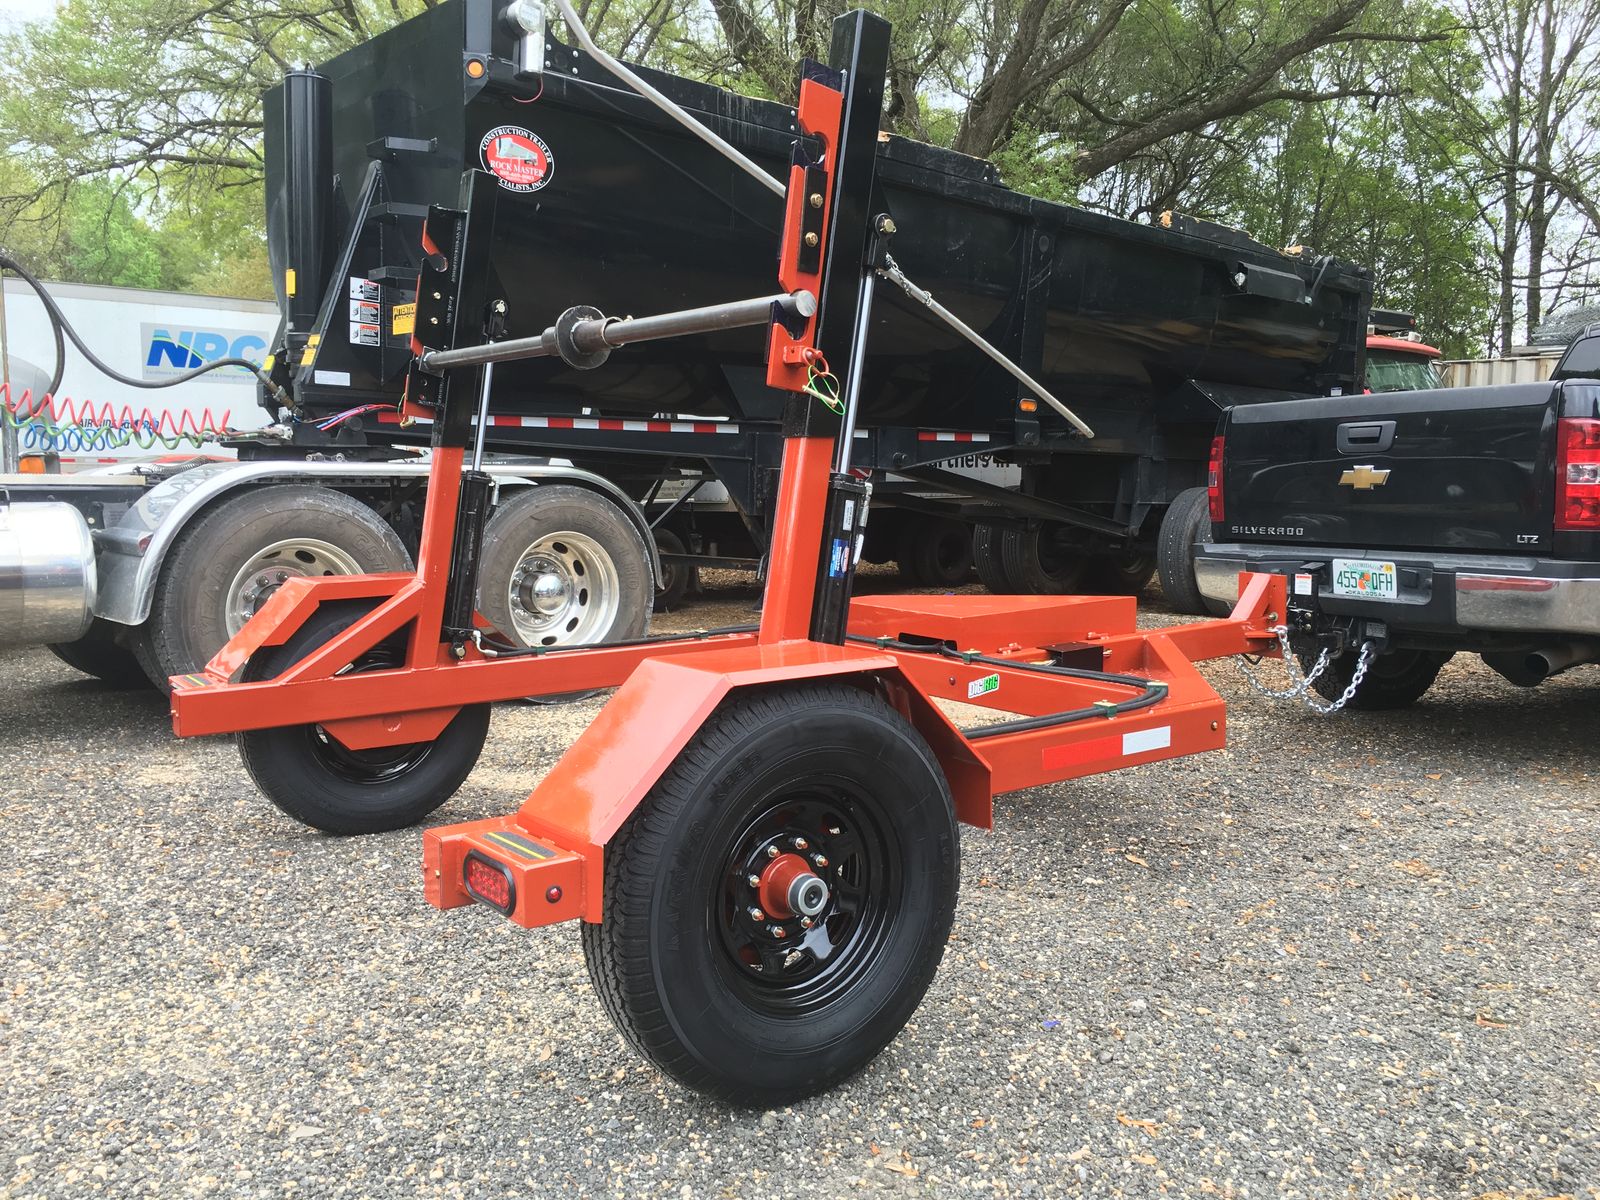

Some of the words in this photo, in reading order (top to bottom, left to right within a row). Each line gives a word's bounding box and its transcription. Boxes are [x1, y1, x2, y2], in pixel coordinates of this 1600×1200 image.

[482, 128, 528, 150] CONSTRUCTION
[528, 133, 552, 163] TRAILER
[490, 160, 512, 171] ROCK
[514, 163, 544, 177] MASTER
[1231, 526, 1304, 536] SILVERADO
[1516, 534, 1539, 544] LTZ
[1337, 571, 1358, 589] 455
[1371, 572, 1393, 591] QFH
